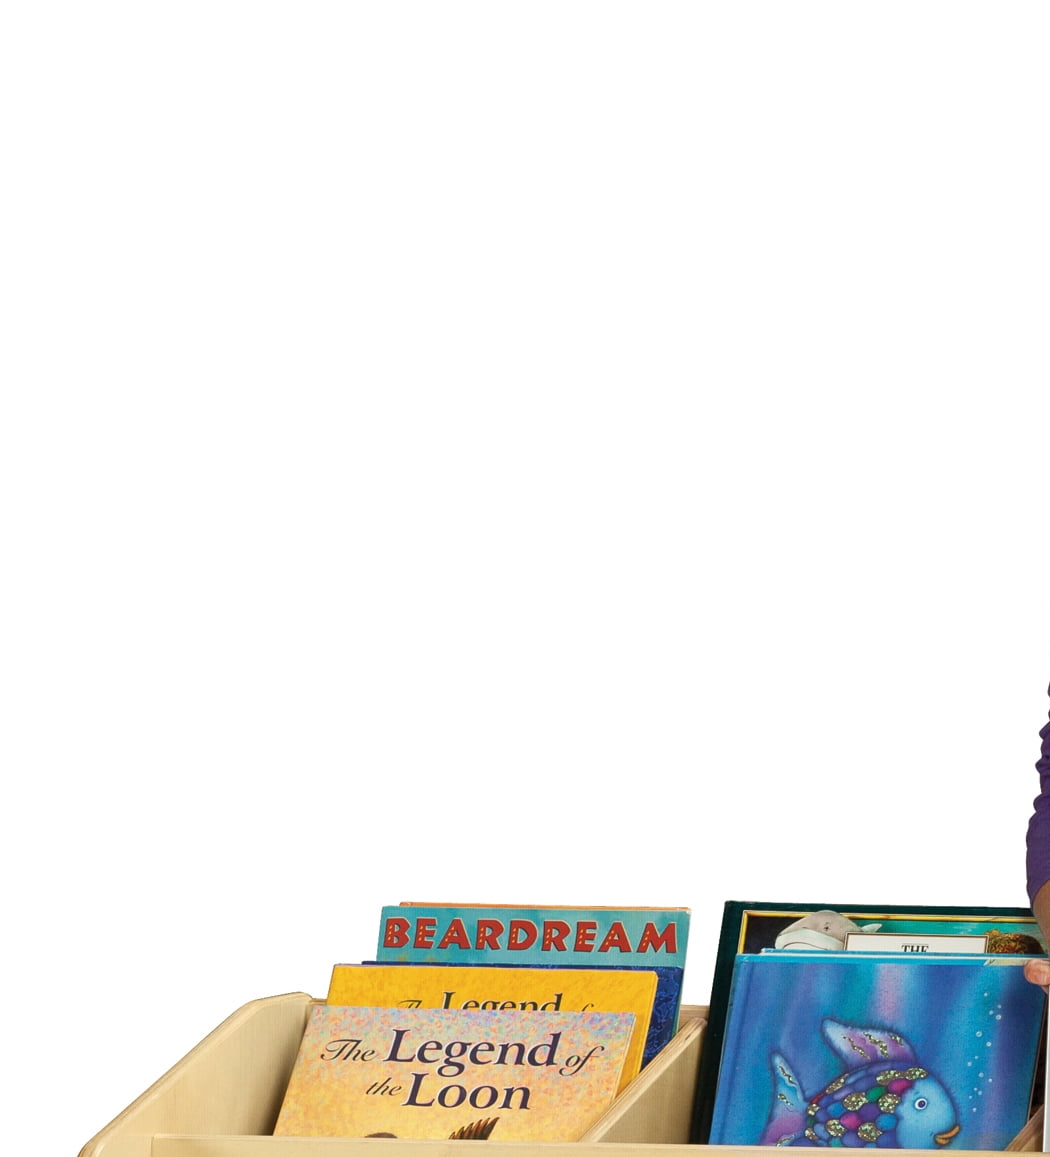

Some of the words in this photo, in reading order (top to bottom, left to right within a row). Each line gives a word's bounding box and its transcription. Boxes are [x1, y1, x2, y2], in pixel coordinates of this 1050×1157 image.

[382, 917, 679, 954] BEARDREAM
[320, 1037, 377, 1063] The
[382, 1028, 562, 1078] Legend
[559, 1045, 605, 1076] of
[365, 1076, 402, 1097] the
[401, 1072, 531, 1111] Loon
